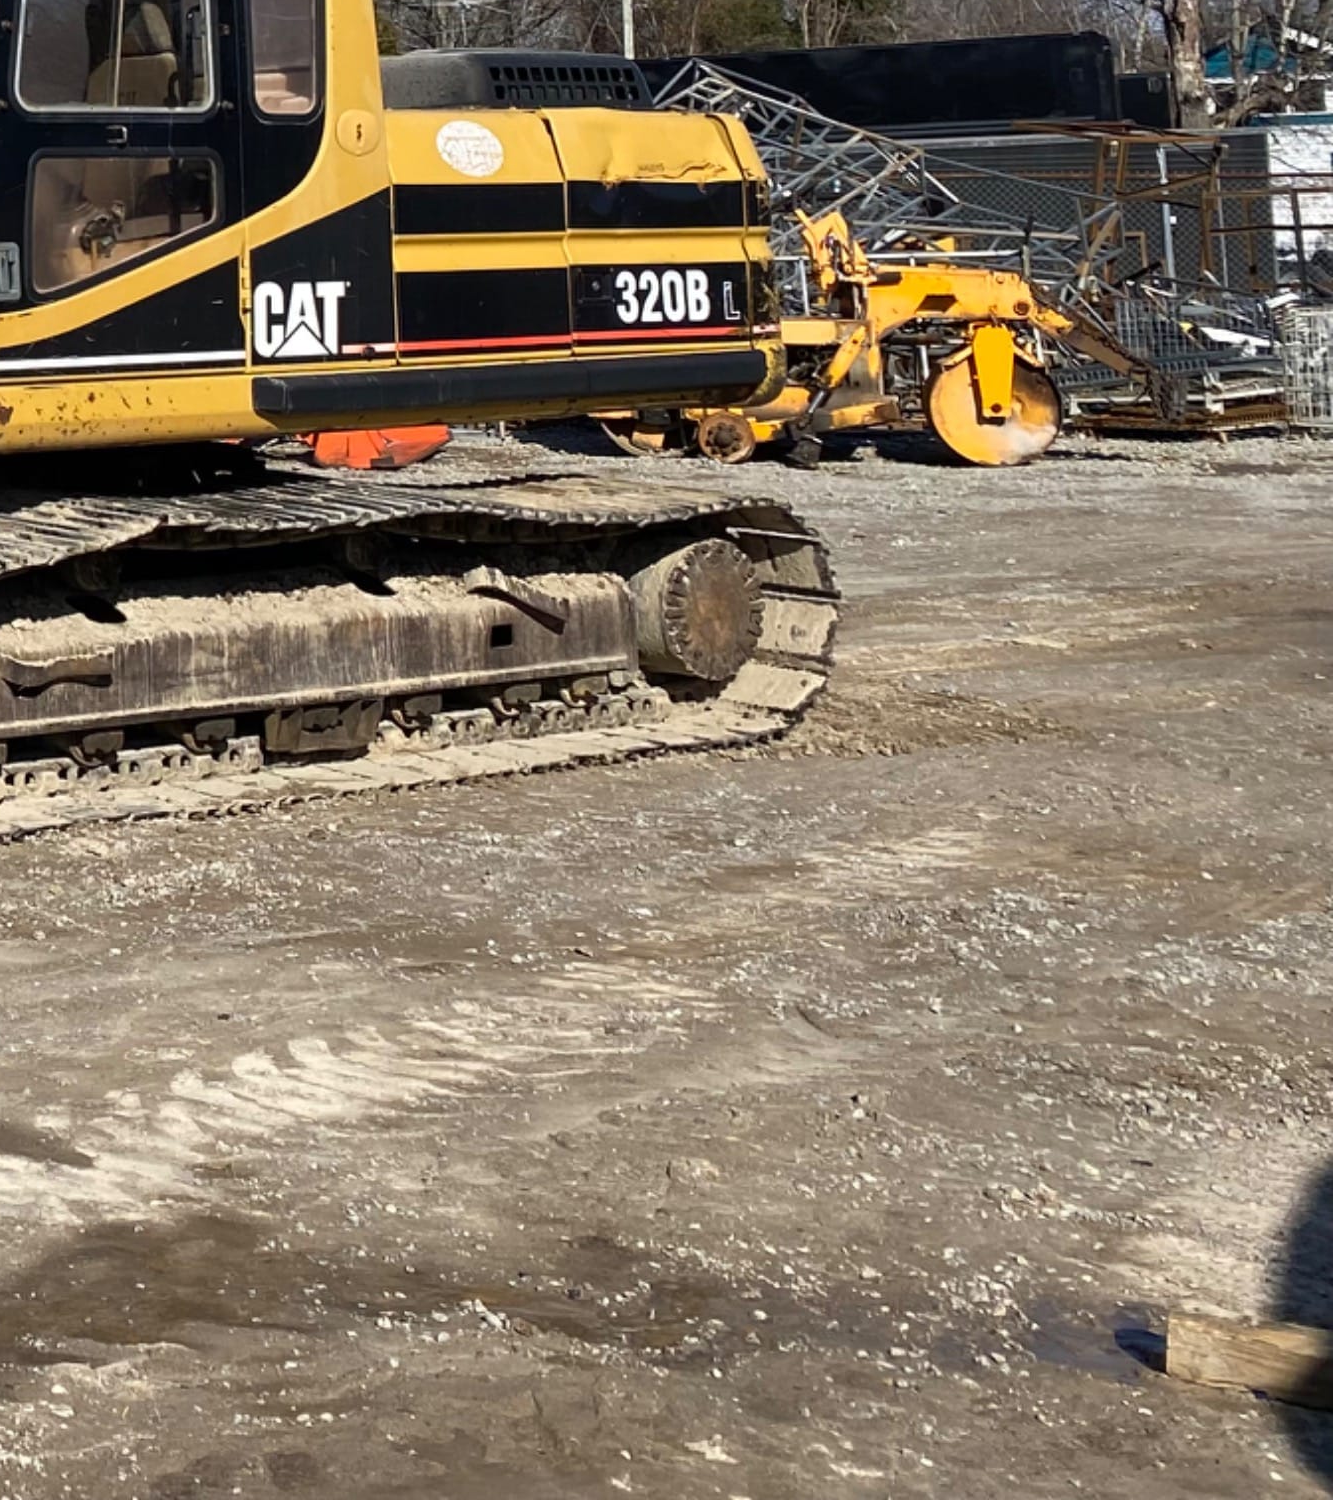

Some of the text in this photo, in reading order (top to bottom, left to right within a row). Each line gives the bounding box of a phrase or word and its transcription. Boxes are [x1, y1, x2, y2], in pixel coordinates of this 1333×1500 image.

[254, 281, 346, 358] CAT
[615, 269, 740, 324] 320B L
